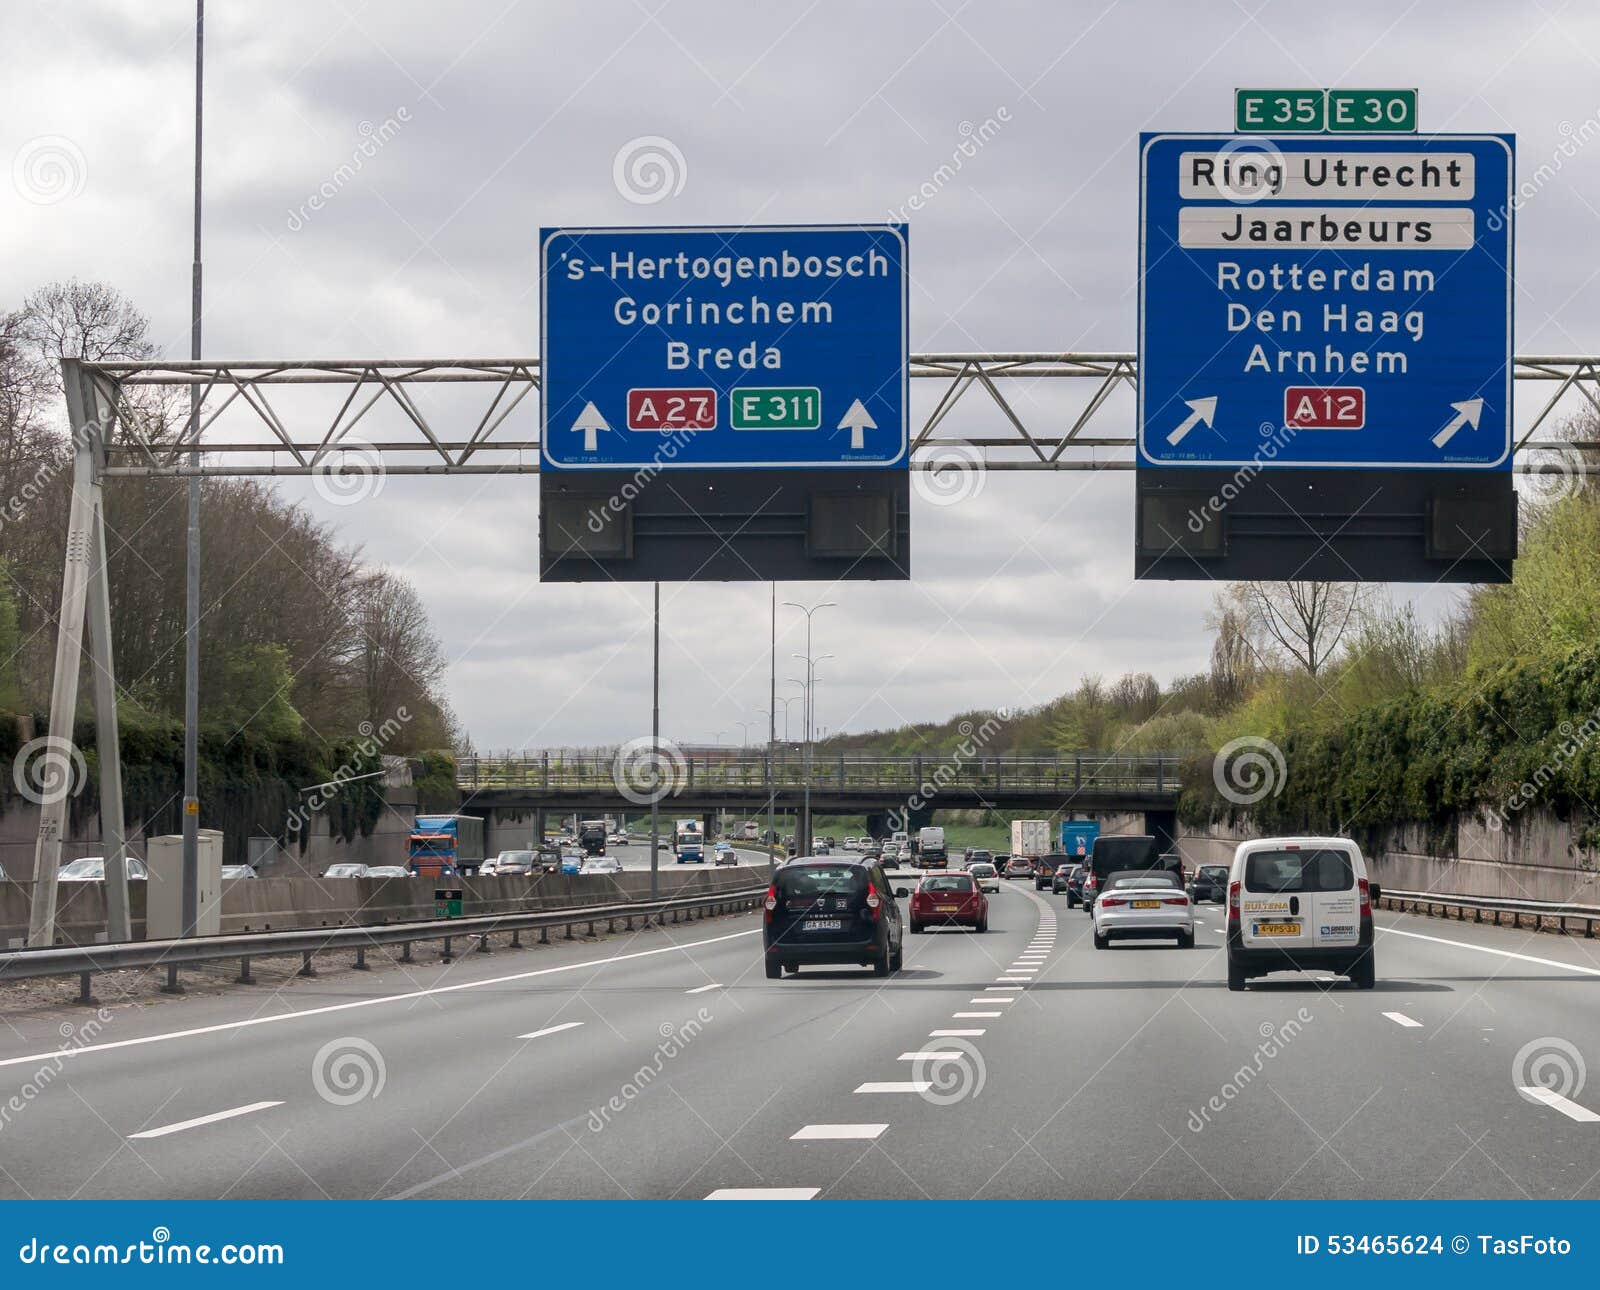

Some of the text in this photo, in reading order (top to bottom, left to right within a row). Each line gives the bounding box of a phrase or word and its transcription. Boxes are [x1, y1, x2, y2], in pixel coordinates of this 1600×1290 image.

[1192, 158, 1461, 195] Ring Utrecht
[1221, 213, 1432, 243] Jaarbeurs
[1218, 262, 1434, 291] Rotterdam
[614, 296, 832, 325] Gorinchem
[1228, 303, 1424, 341] Den Haag
[667, 341, 781, 370] Breda
[1244, 344, 1407, 373] Arnhem
